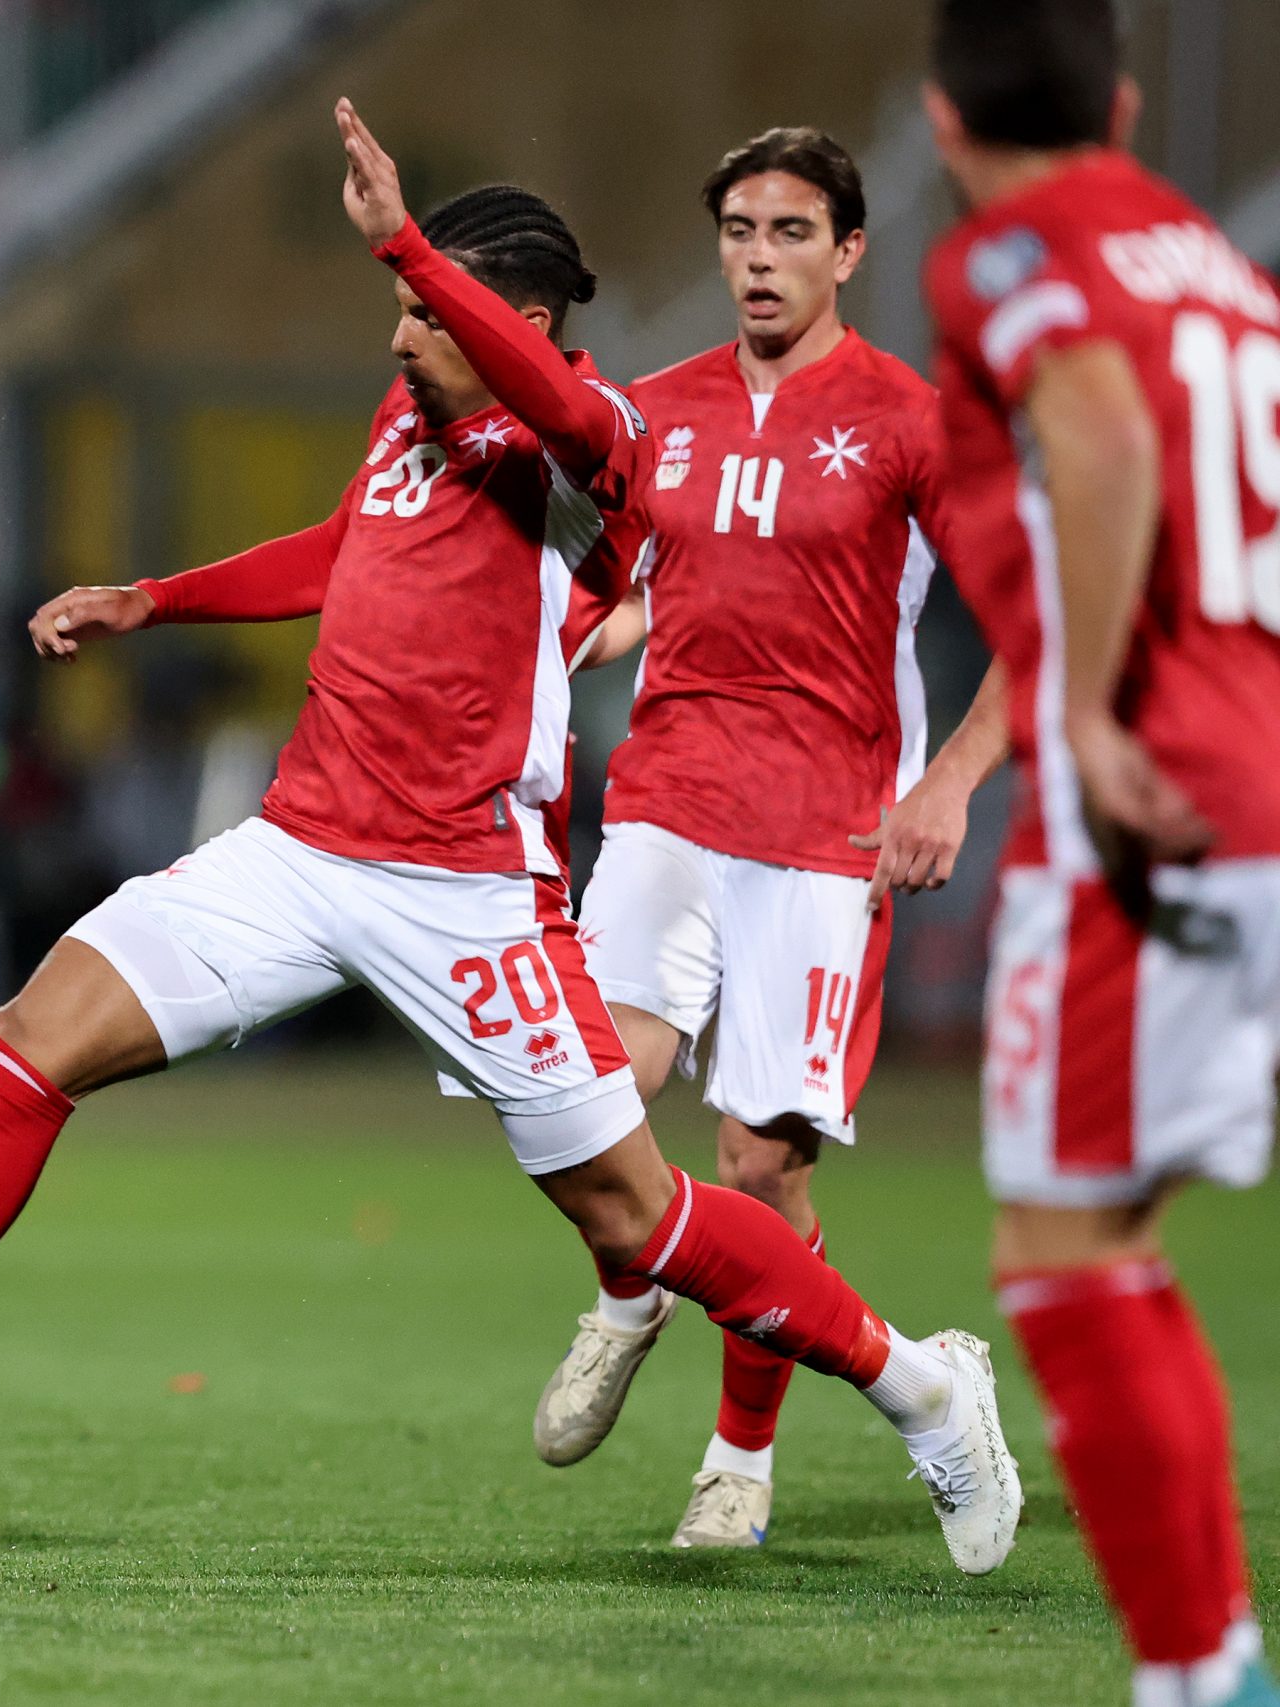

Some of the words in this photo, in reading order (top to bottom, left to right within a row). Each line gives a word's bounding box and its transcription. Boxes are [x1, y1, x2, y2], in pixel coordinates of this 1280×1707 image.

[360, 443, 448, 518] 20
[713, 453, 785, 538] 14
[450, 940, 559, 1039] 20
[804, 967, 852, 1054] 14
